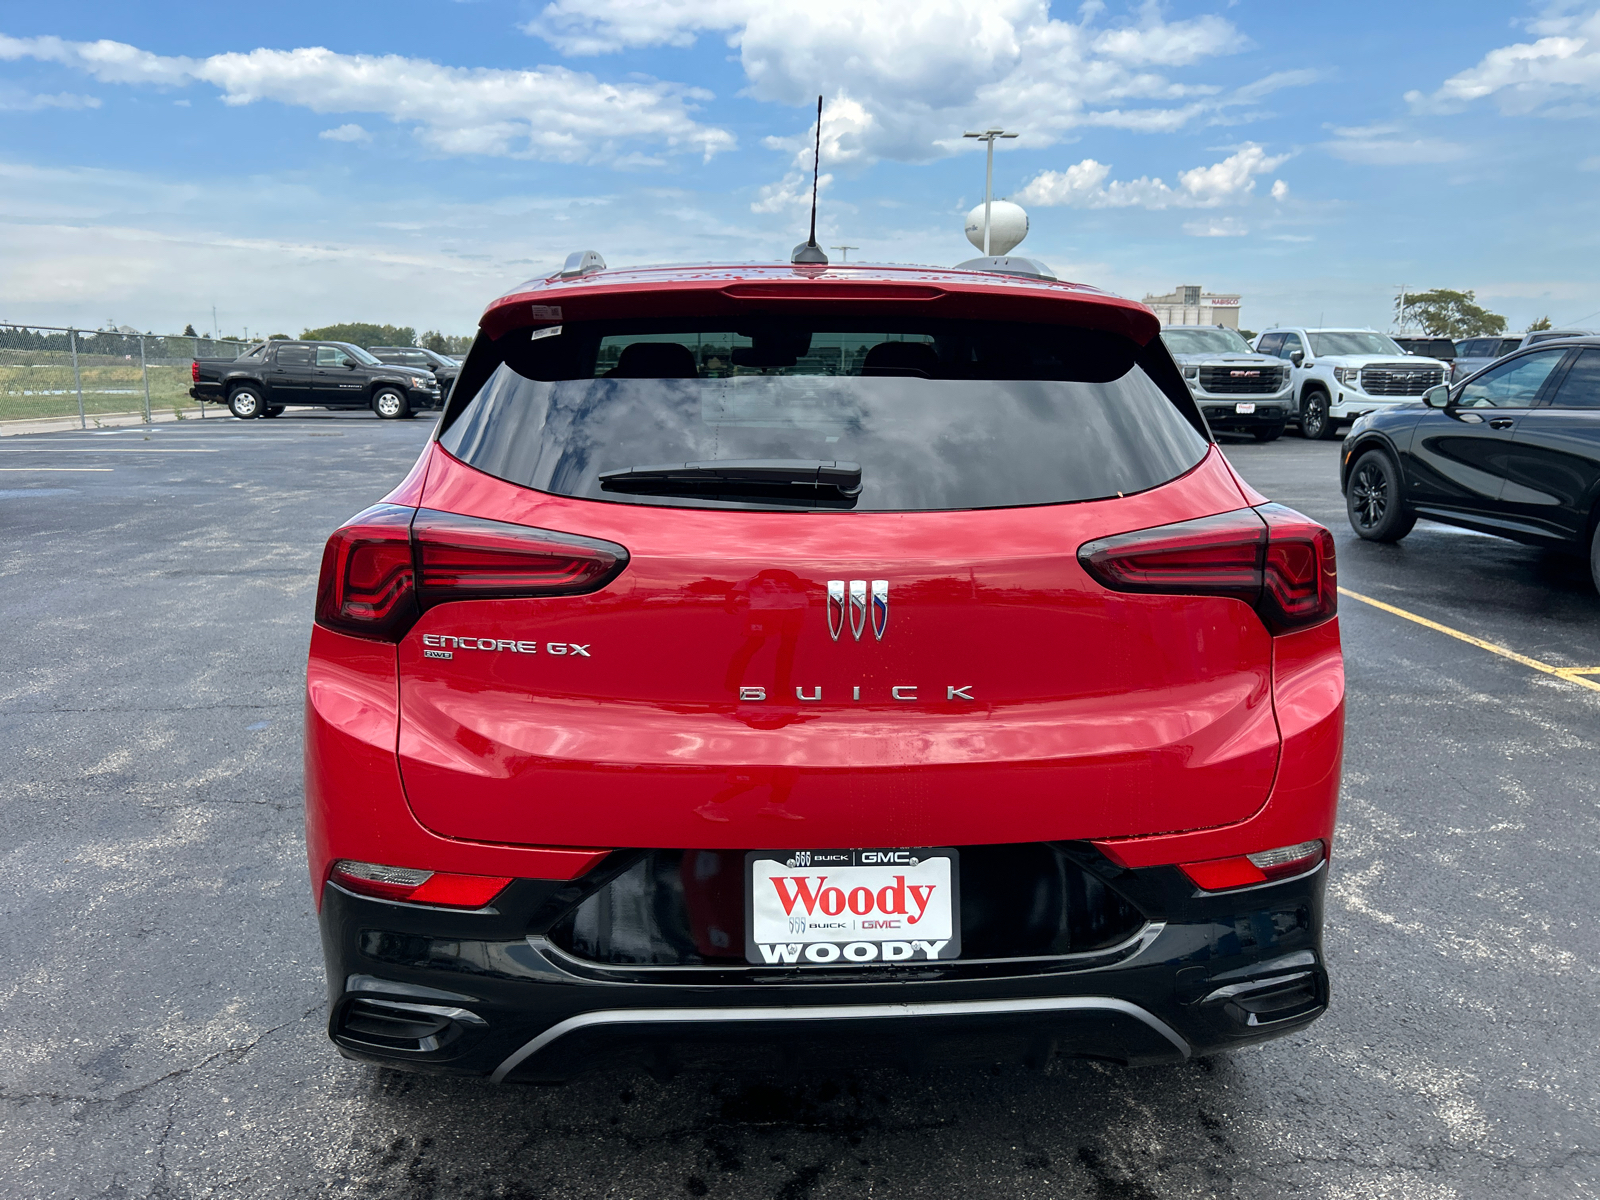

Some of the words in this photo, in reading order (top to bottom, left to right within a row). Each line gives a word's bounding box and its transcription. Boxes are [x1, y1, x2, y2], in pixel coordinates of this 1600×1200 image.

[1230, 370, 1260, 378] GMC
[422, 633, 537, 653] ENCORE
[546, 642, 591, 657] GX
[739, 686, 975, 701] BUICK
[861, 851, 910, 863] GMC
[768, 875, 937, 925] Woody
[861, 919, 901, 929] GMC
[758, 940, 949, 964] WOODY
